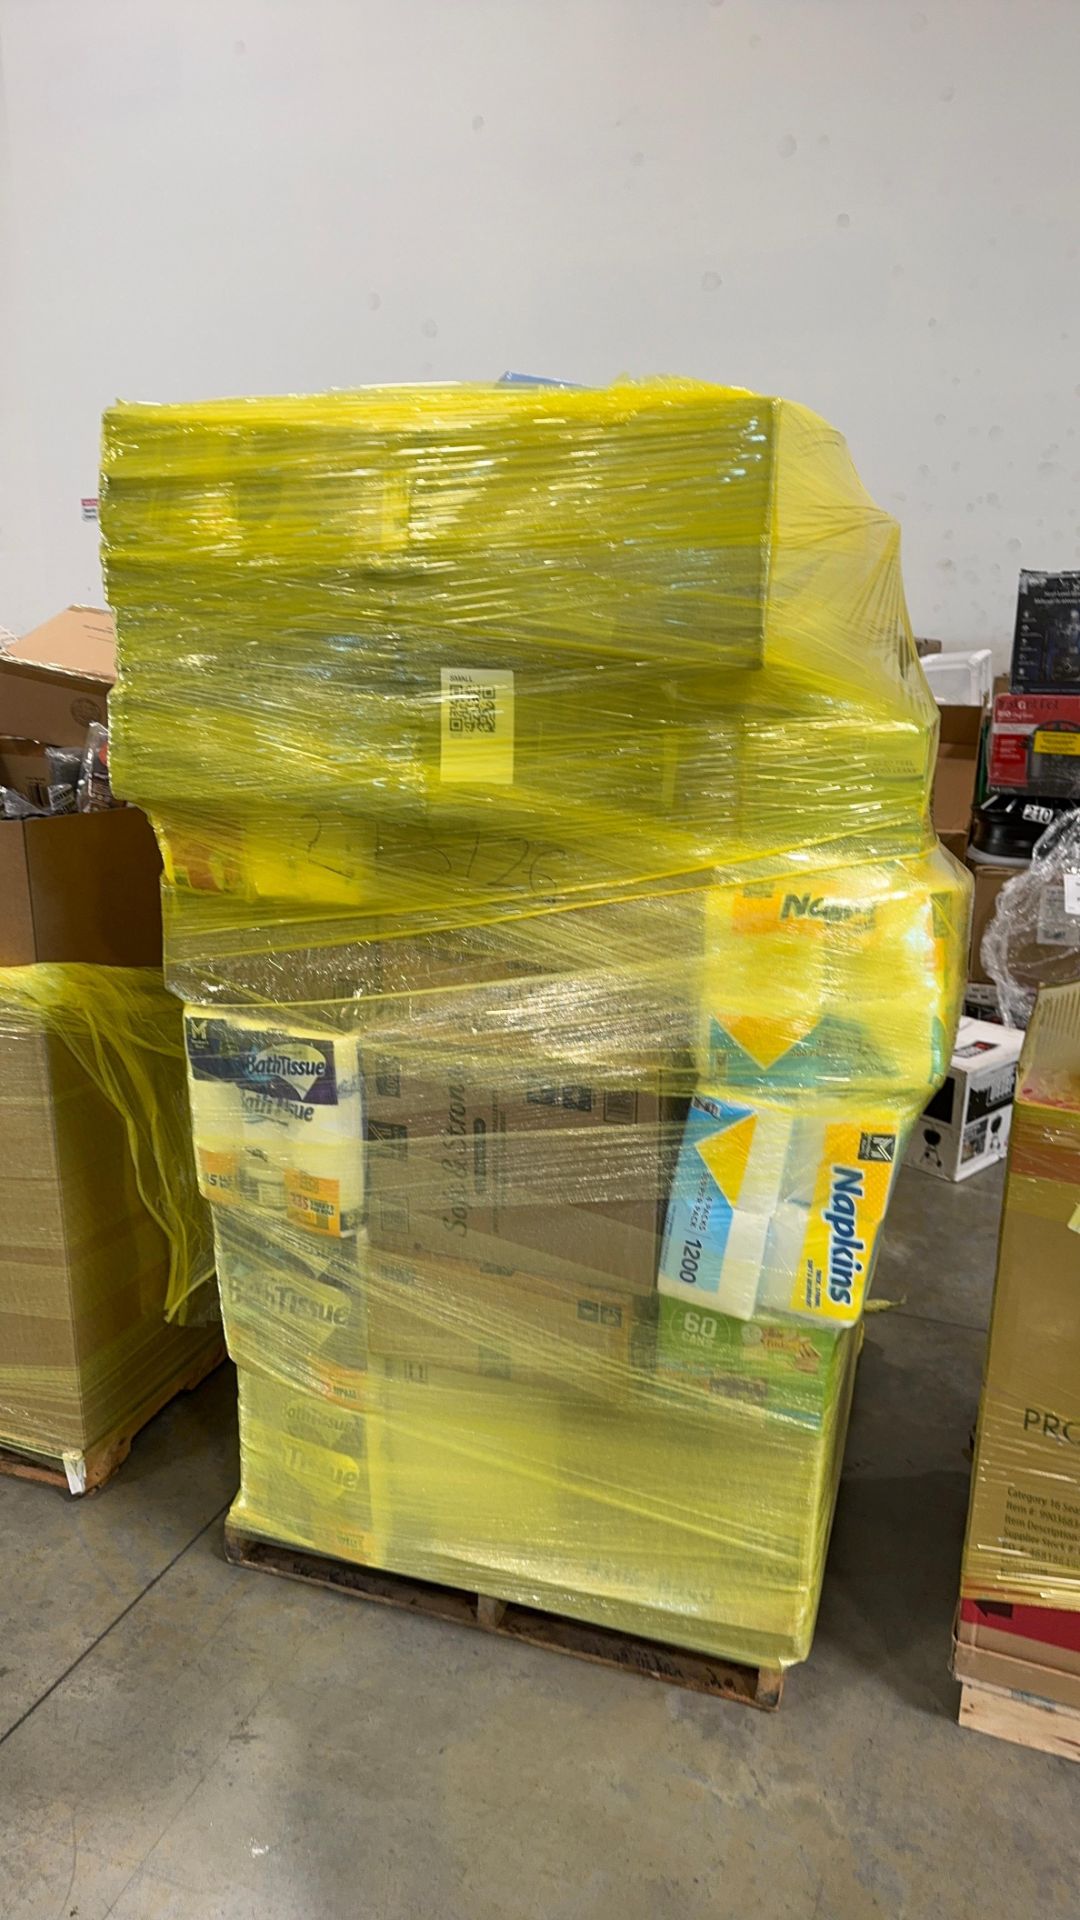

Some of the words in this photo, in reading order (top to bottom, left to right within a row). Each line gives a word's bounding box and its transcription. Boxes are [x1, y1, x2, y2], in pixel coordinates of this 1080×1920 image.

[823, 1164, 864, 1306] Napkins
[680, 1239, 702, 1284] 1200
[684, 1311, 718, 1339] 60
[1007, 1486, 1047, 1506] Category
